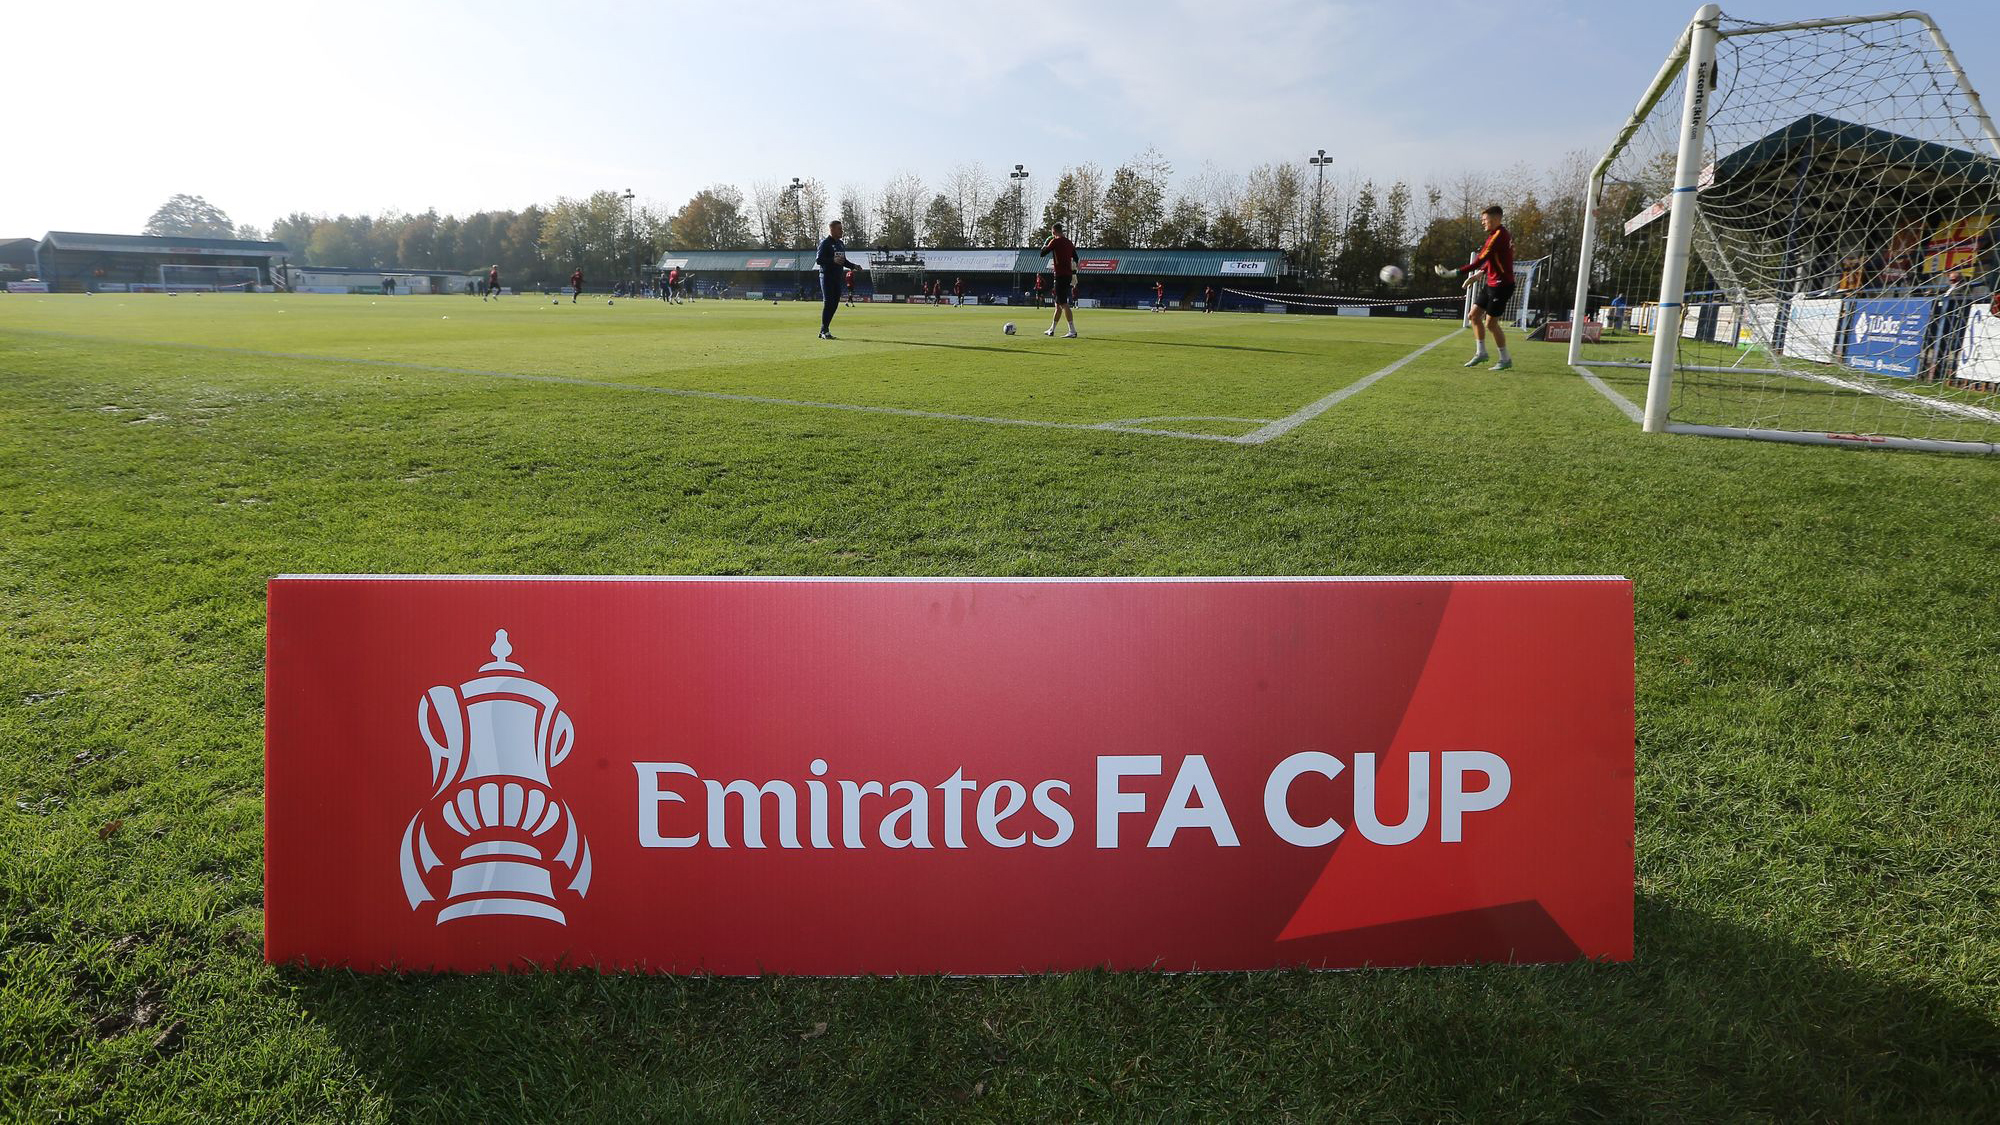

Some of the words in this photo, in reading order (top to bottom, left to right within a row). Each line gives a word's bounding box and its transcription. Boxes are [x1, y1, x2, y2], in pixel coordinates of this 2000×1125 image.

[632, 758, 1075, 849] Emirates
[1096, 754, 1241, 849] FA
[1263, 750, 1512, 847] CUP
